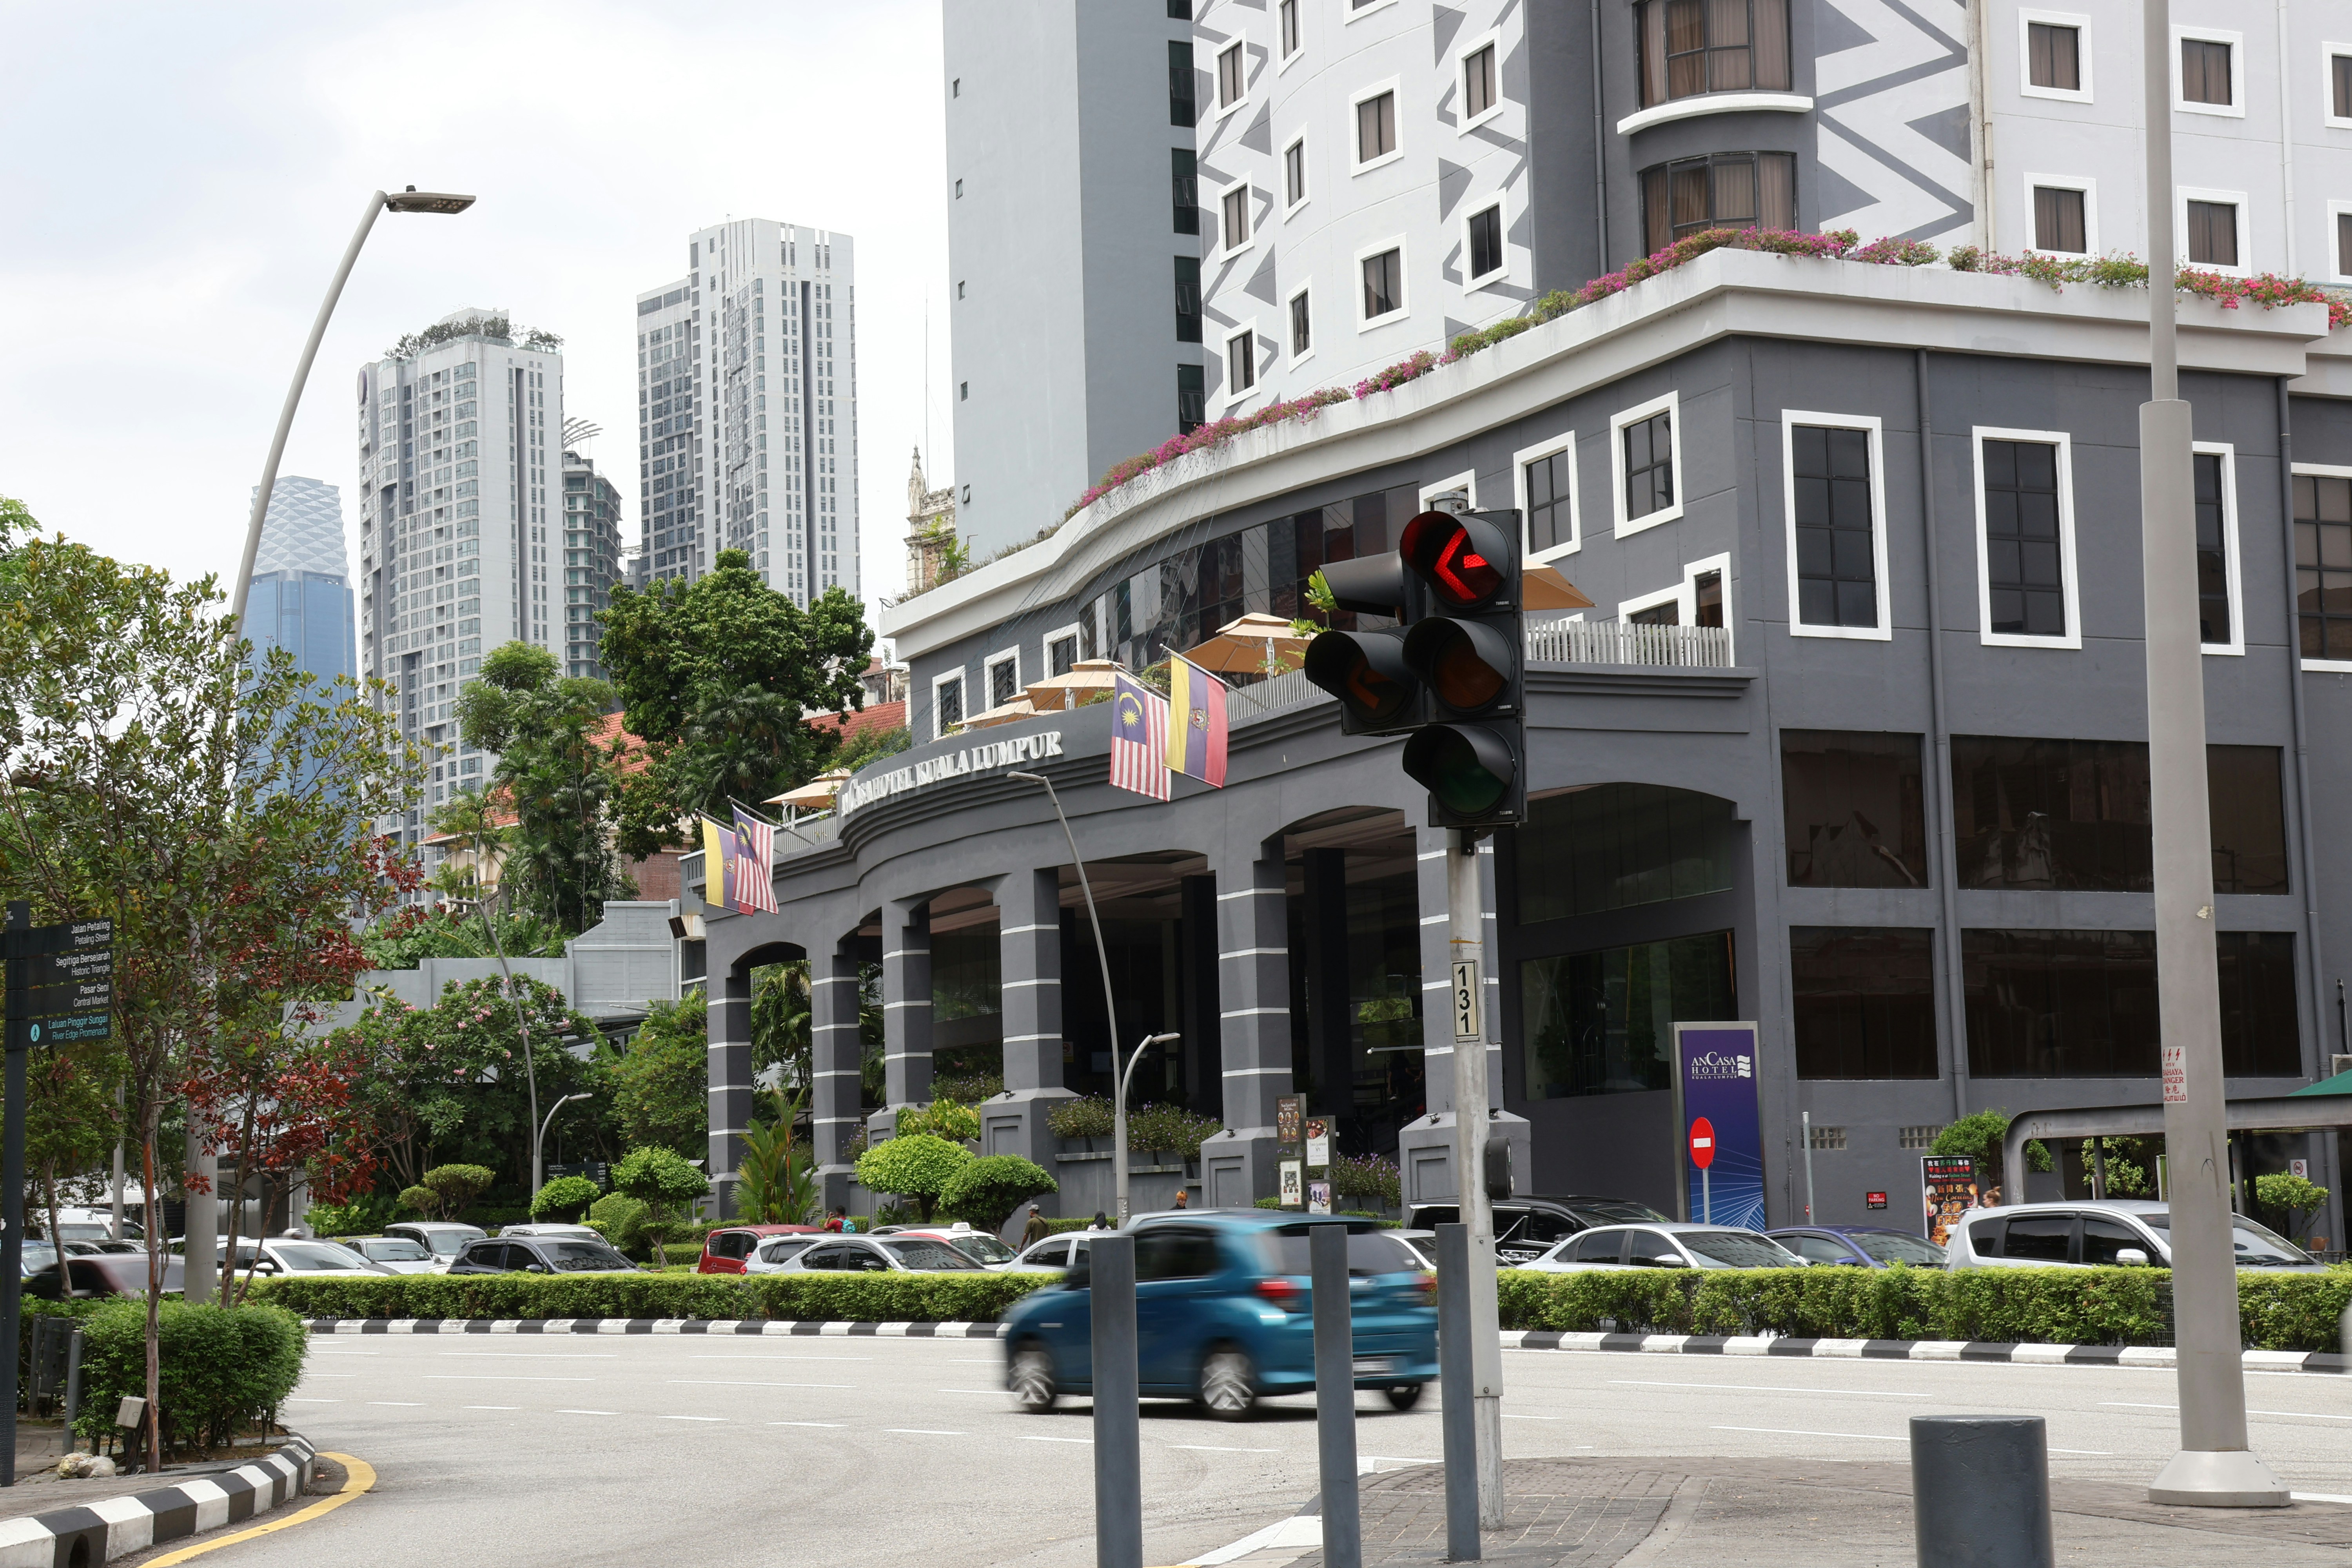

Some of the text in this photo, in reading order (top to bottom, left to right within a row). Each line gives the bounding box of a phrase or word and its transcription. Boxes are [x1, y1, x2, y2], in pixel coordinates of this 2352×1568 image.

[872, 766, 916, 800] HOTEL
[915, 750, 971, 787] KUALA
[971, 731, 1064, 772] LUMPUR
[71, 920, 110, 934] Jalan Petaling
[75, 932, 110, 945] Petaling Street
[56, 951, 110, 968] Segitiga Bersejarah
[71, 963, 110, 976] Historic Triangle
[80, 982, 109, 995] Pasar Seni
[73, 995, 109, 1007] Central Market
[1458, 965, 1470, 1033] 131
[48, 1013, 108, 1029] Laluan Pinggir Sungai
[52, 1026, 108, 1040] River Edge Promenade
